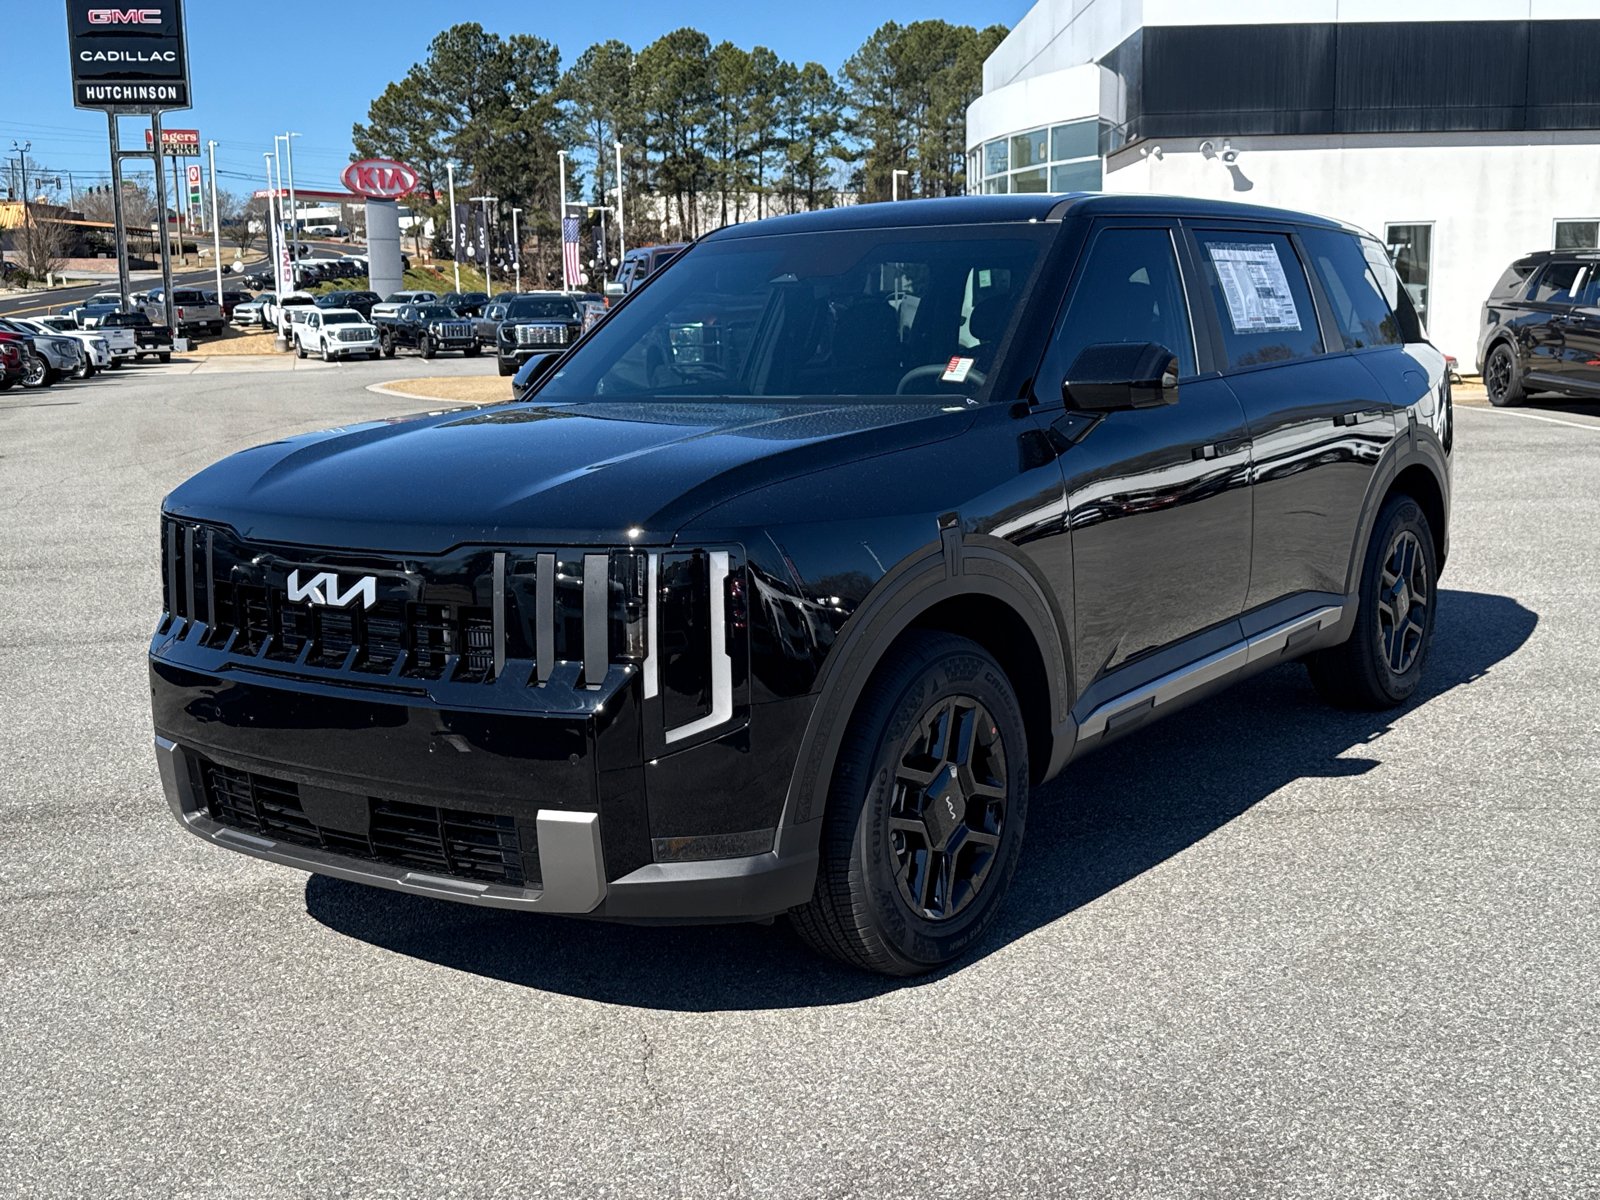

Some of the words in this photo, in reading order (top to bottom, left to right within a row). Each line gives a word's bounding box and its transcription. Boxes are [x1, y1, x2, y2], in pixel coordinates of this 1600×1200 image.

[88, 9, 162, 24] GMC
[80, 51, 176, 62] CADILLAC
[86, 86, 177, 99] HUTCHINSON
[356, 167, 407, 190] KIA
[286, 568, 377, 610] KIA
[872, 767, 888, 864] KUMHO
